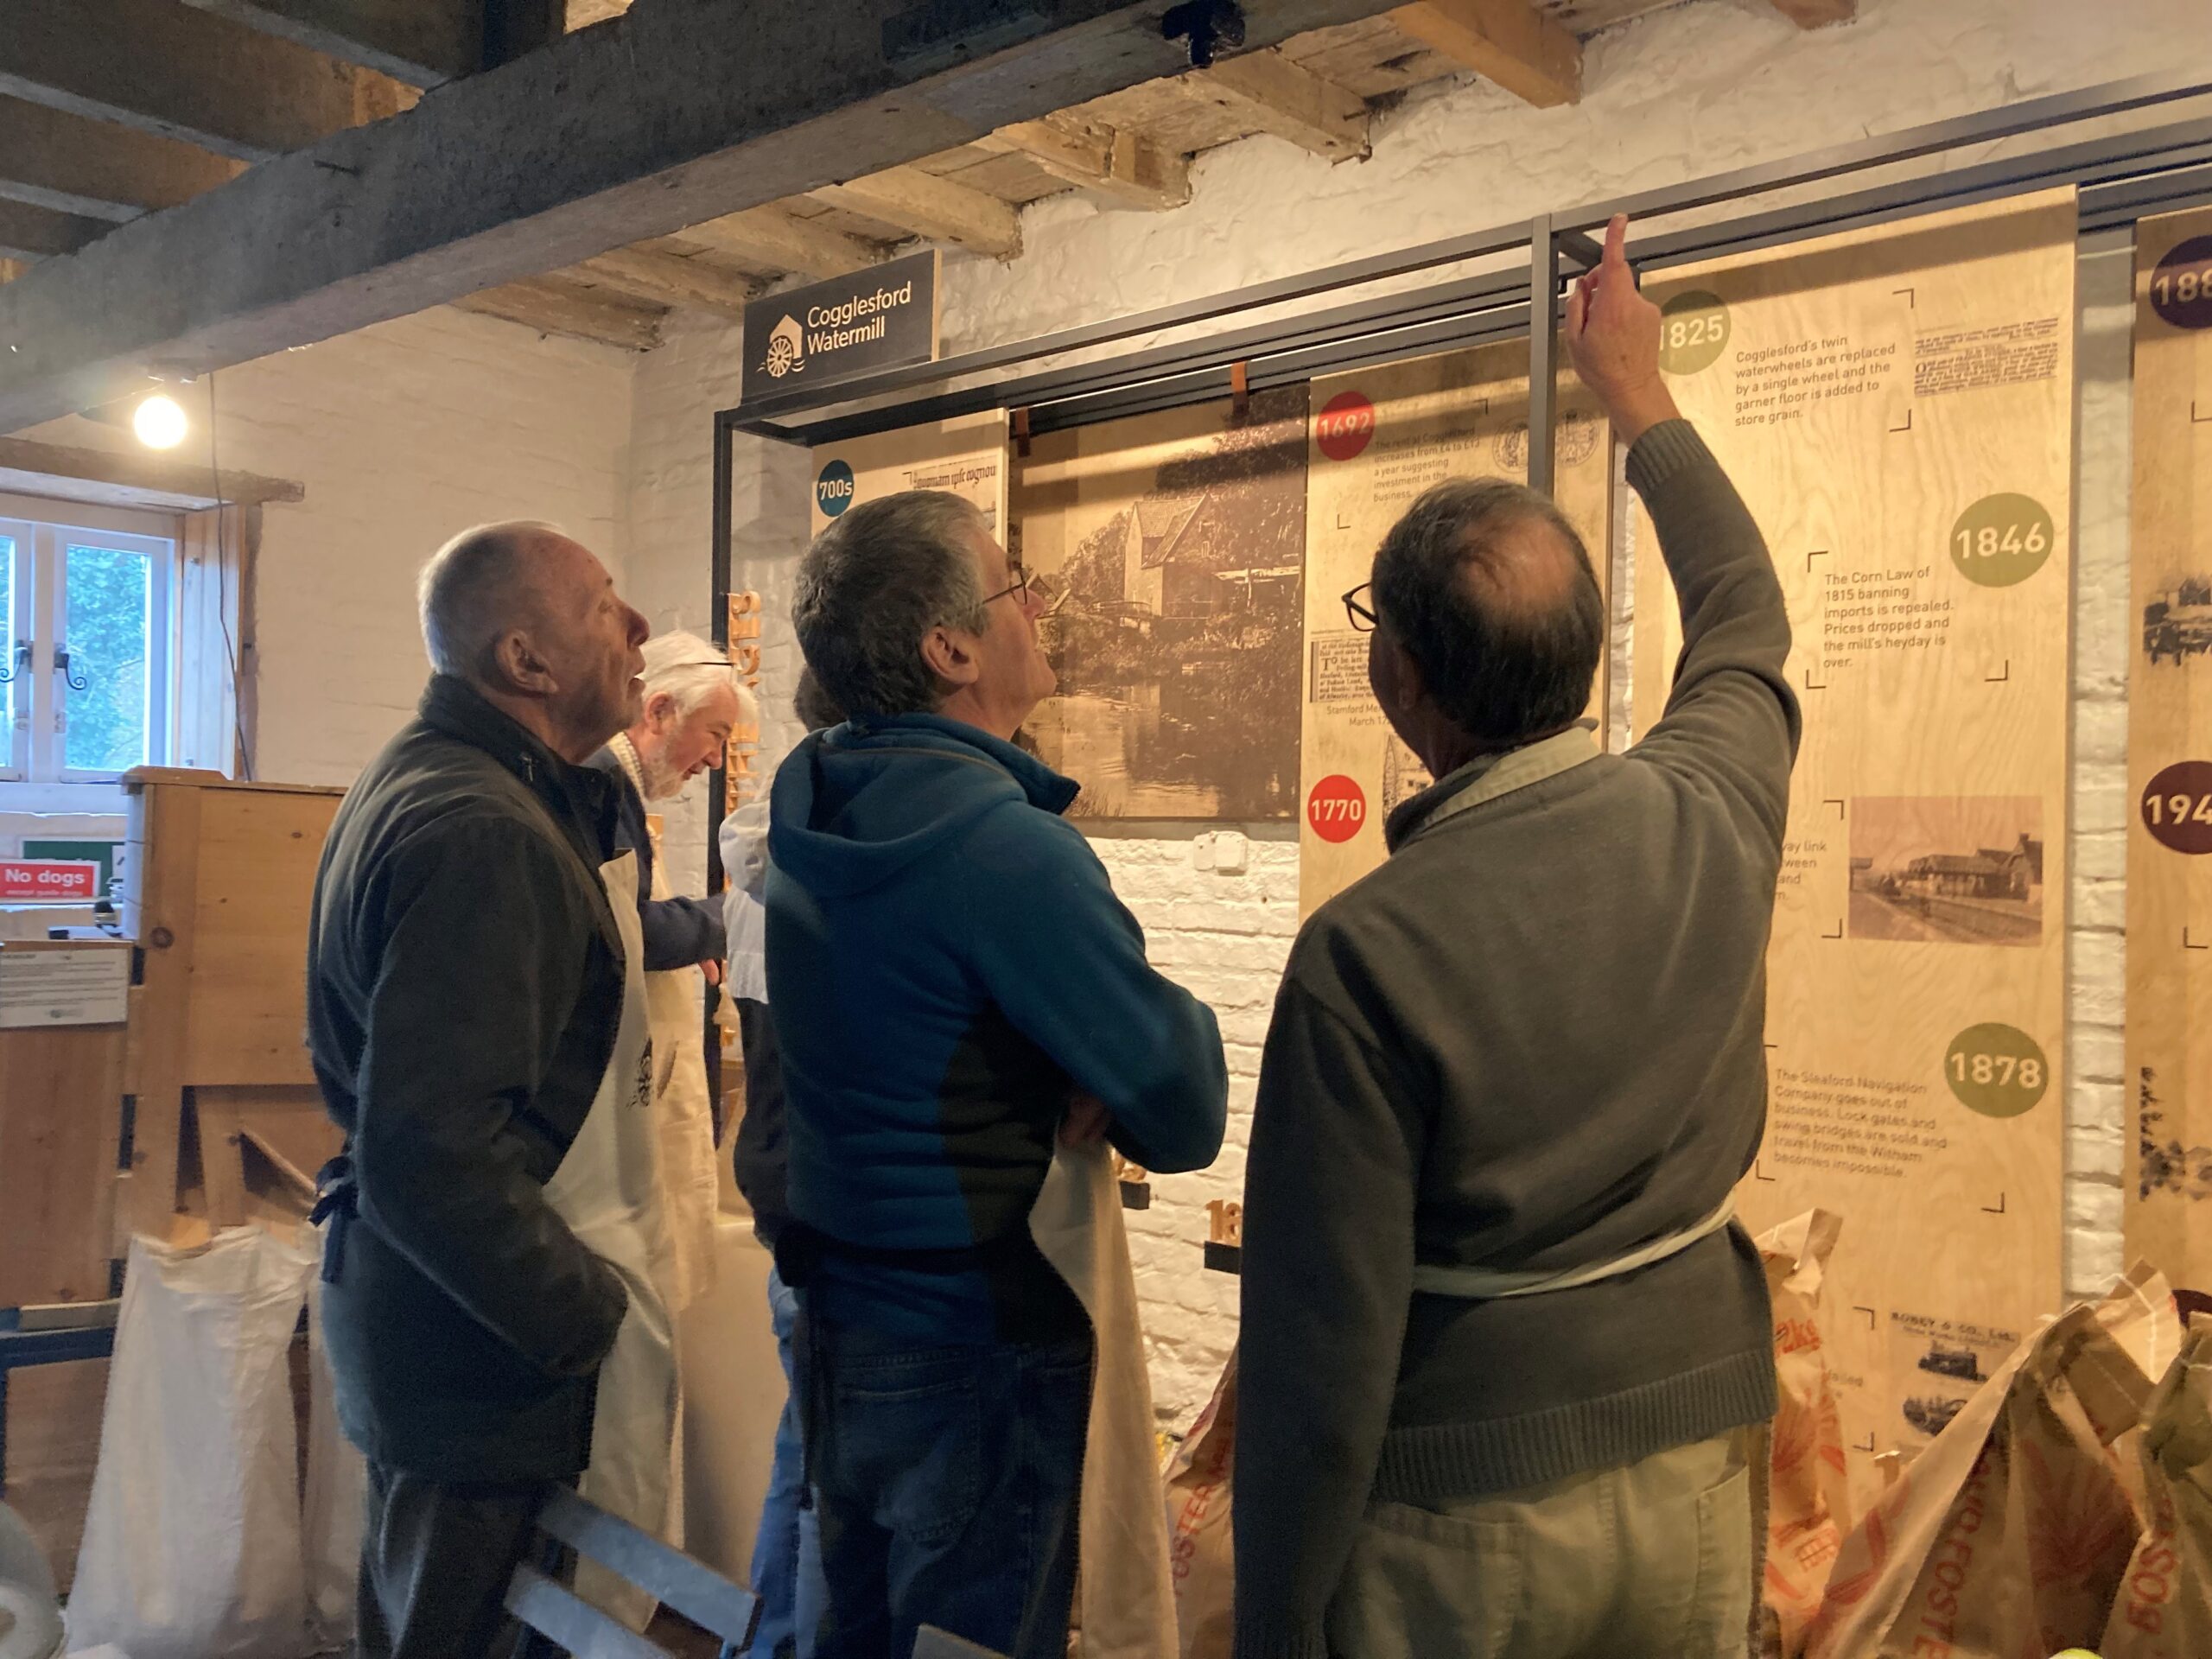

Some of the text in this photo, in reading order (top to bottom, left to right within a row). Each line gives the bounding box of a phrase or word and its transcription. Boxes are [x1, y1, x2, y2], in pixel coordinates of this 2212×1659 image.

[807, 280, 912, 328] Cogglesford
[807, 315, 886, 355] Watermill
[1660, 314, 1724, 352] 1825
[1736, 335, 1848, 363] Cogglesford's twin
[1736, 342, 1897, 378] waterwheels are replaced
[1736, 361, 1891, 397] by a single wheel and the
[1735, 381, 1880, 413] garner floor is added to
[1320, 411, 1370, 440] 1692
[1735, 407, 1803, 427] store grain.
[1374, 450, 1414, 463] increases
[1417, 446, 1438, 457] from
[1453, 442, 1462, 451] to
[1381, 466, 1400, 478] year
[1402, 458, 1449, 474] suggesting
[819, 479, 852, 500] 700s
[1373, 475, 1421, 489] investment
[1422, 473, 1431, 482] in
[1956, 522, 2046, 559] 1846
[1825, 565, 1930, 586] The Corn Law of
[1826, 586, 1910, 602] 1815 banning
[1824, 600, 1955, 620] imports is repealed.
[1824, 617, 1950, 635] Prices dropped and
[1824, 635, 1947, 652] the mill's heyday is
[1823, 658, 1853, 669] over.
[1326, 703, 1363, 715] Stamford
[1350, 716, 1375, 727] March
[1311, 798, 1362, 822] 1770
[2145, 794, 2212, 825] 194
[1803, 838, 1827, 853] link
[5, 868, 86, 887] No dogs
[1950, 1052, 2041, 1090] 1878
[1774, 1085, 1833, 1103] Company
[1836, 1093, 1866, 1107] goes
[1858, 1077, 1927, 1094] Navigation
[1837, 1109, 1866, 1122] Lock
[1872, 1113, 1908, 1128] gates
[1910, 1116, 1936, 1130] and
[1814, 1123, 1861, 1141] bridges
[1865, 1130, 1887, 1141] are
[1891, 1132, 1918, 1145] sold
[1922, 1135, 1948, 1149] and
[1813, 1138, 1844, 1154] from
[1846, 1143, 1867, 1156] the
